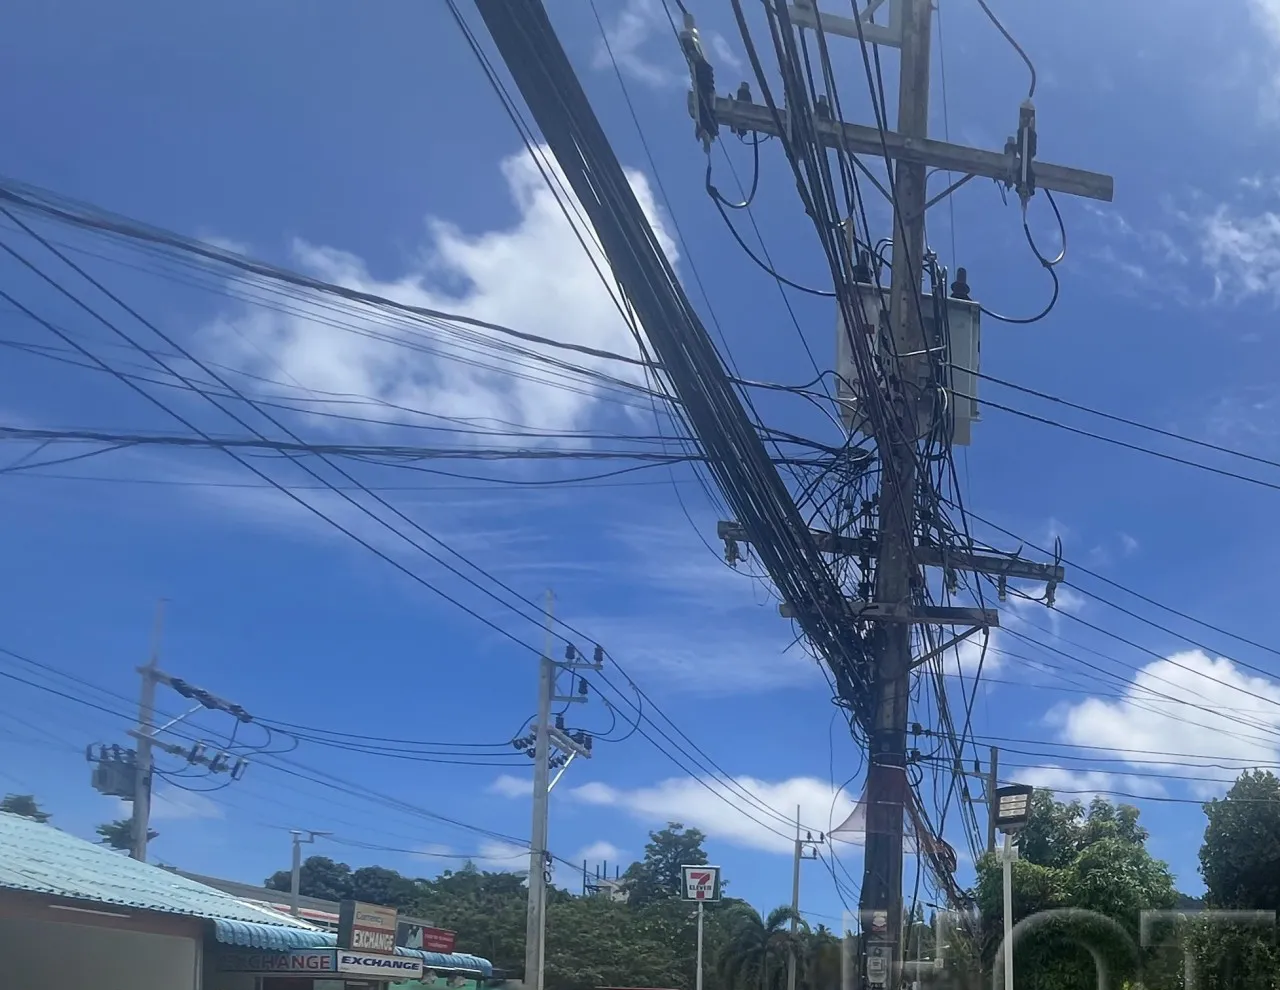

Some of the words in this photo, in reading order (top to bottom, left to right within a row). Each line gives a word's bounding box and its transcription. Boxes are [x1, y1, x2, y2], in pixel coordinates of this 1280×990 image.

[691, 872, 710, 899] 7
[356, 911, 384, 925] Currency
[353, 929, 394, 951] EXCHANGE
[220, 953, 331, 970] EXCHANGE
[340, 955, 421, 971] EXCHANGE
